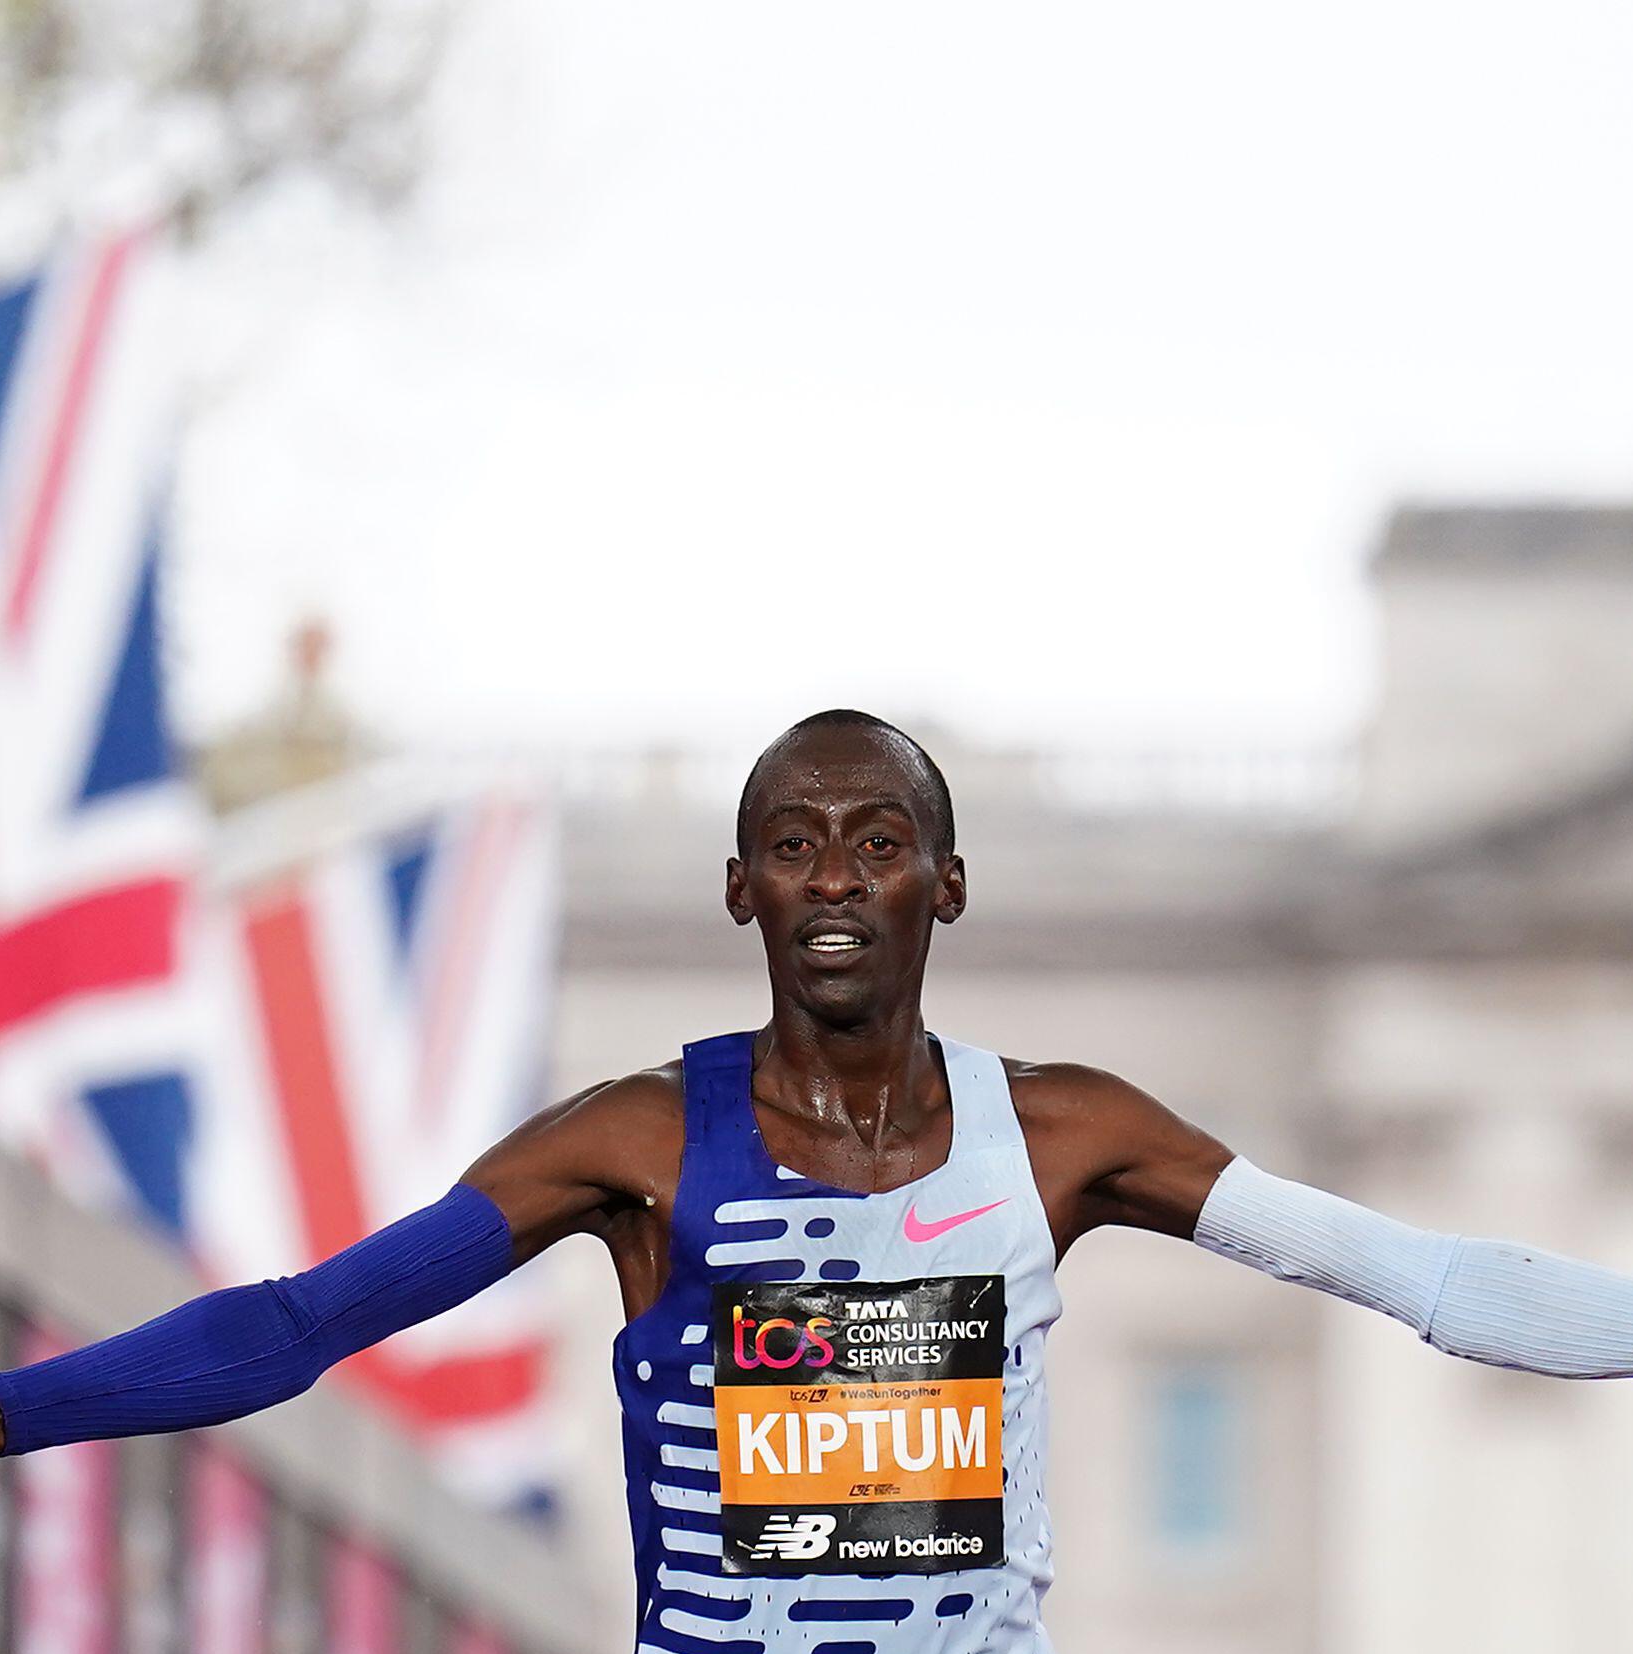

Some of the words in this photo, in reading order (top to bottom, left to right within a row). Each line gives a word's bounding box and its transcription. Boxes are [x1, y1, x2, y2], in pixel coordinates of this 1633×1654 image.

[845, 1300, 909, 1321] TATA
[733, 1305, 835, 1370] tcs
[846, 1320, 989, 1344] CONSULTANCY
[847, 1345, 942, 1368] SERVICES
[737, 1406, 987, 1475] KIPTUM
[750, 1514, 838, 1560] NB
[839, 1540, 891, 1560] new
[895, 1533, 984, 1557] balance
